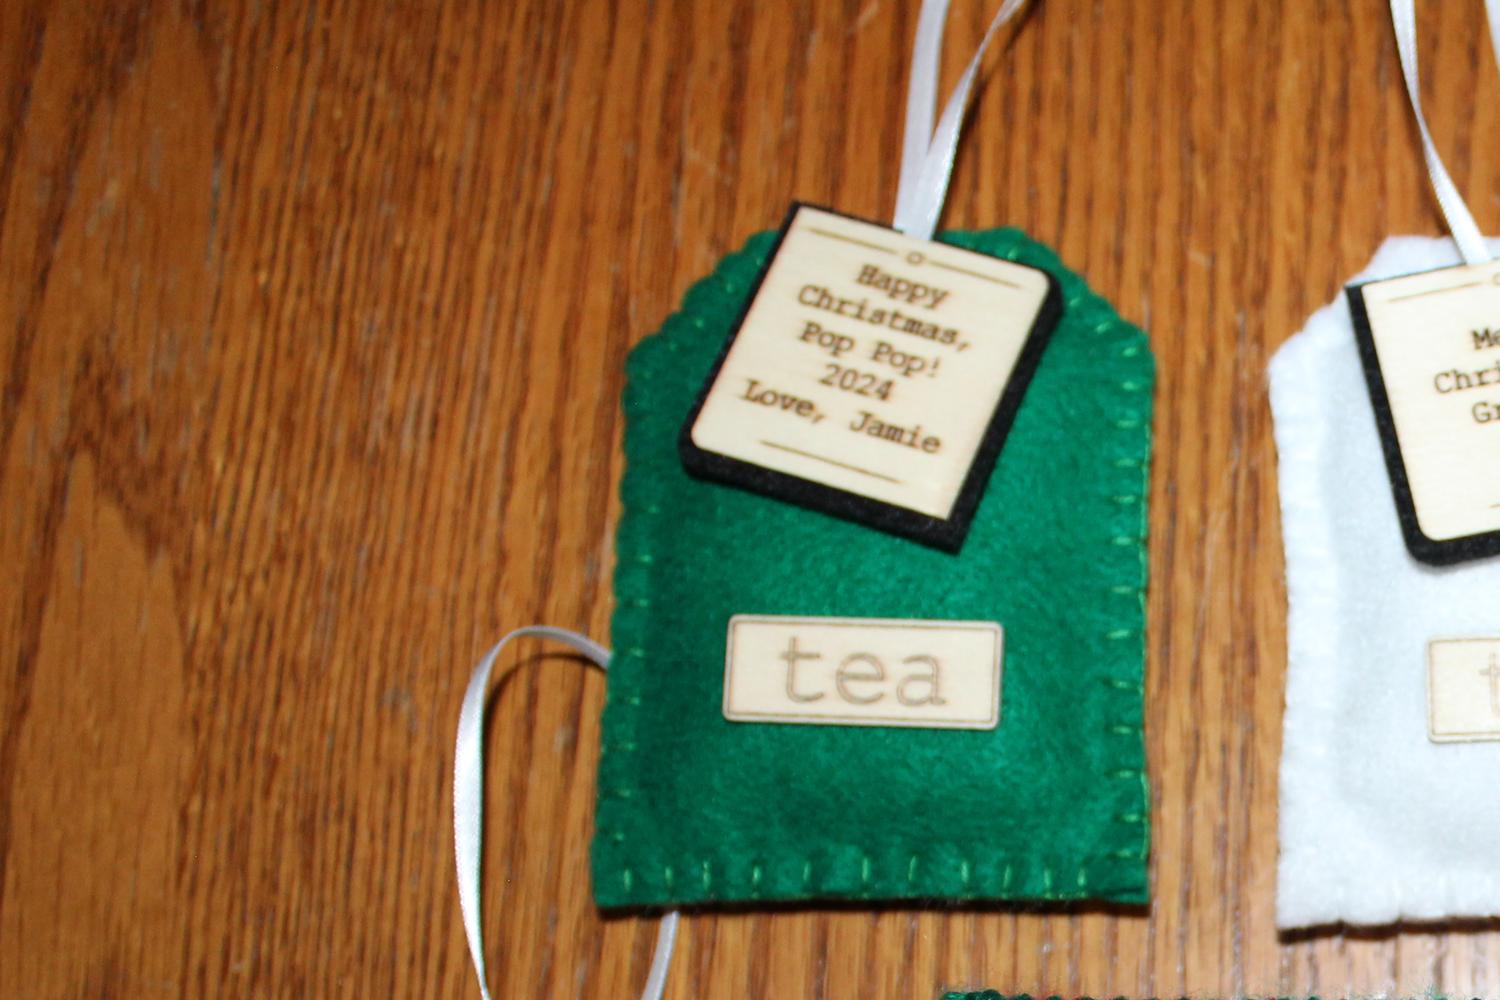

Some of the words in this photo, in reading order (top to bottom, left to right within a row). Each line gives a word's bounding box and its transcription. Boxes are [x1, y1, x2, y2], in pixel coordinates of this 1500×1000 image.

[797, 284, 972, 352] Christmas,
[856, 264, 949, 309] Happy
[798, 320, 854, 357] Pop
[871, 341, 941, 378] Pop!
[820, 364, 896, 400] 2024
[741, 378, 826, 423] Love,
[850, 410, 942, 454] Jamie
[780, 636, 947, 707] tea
